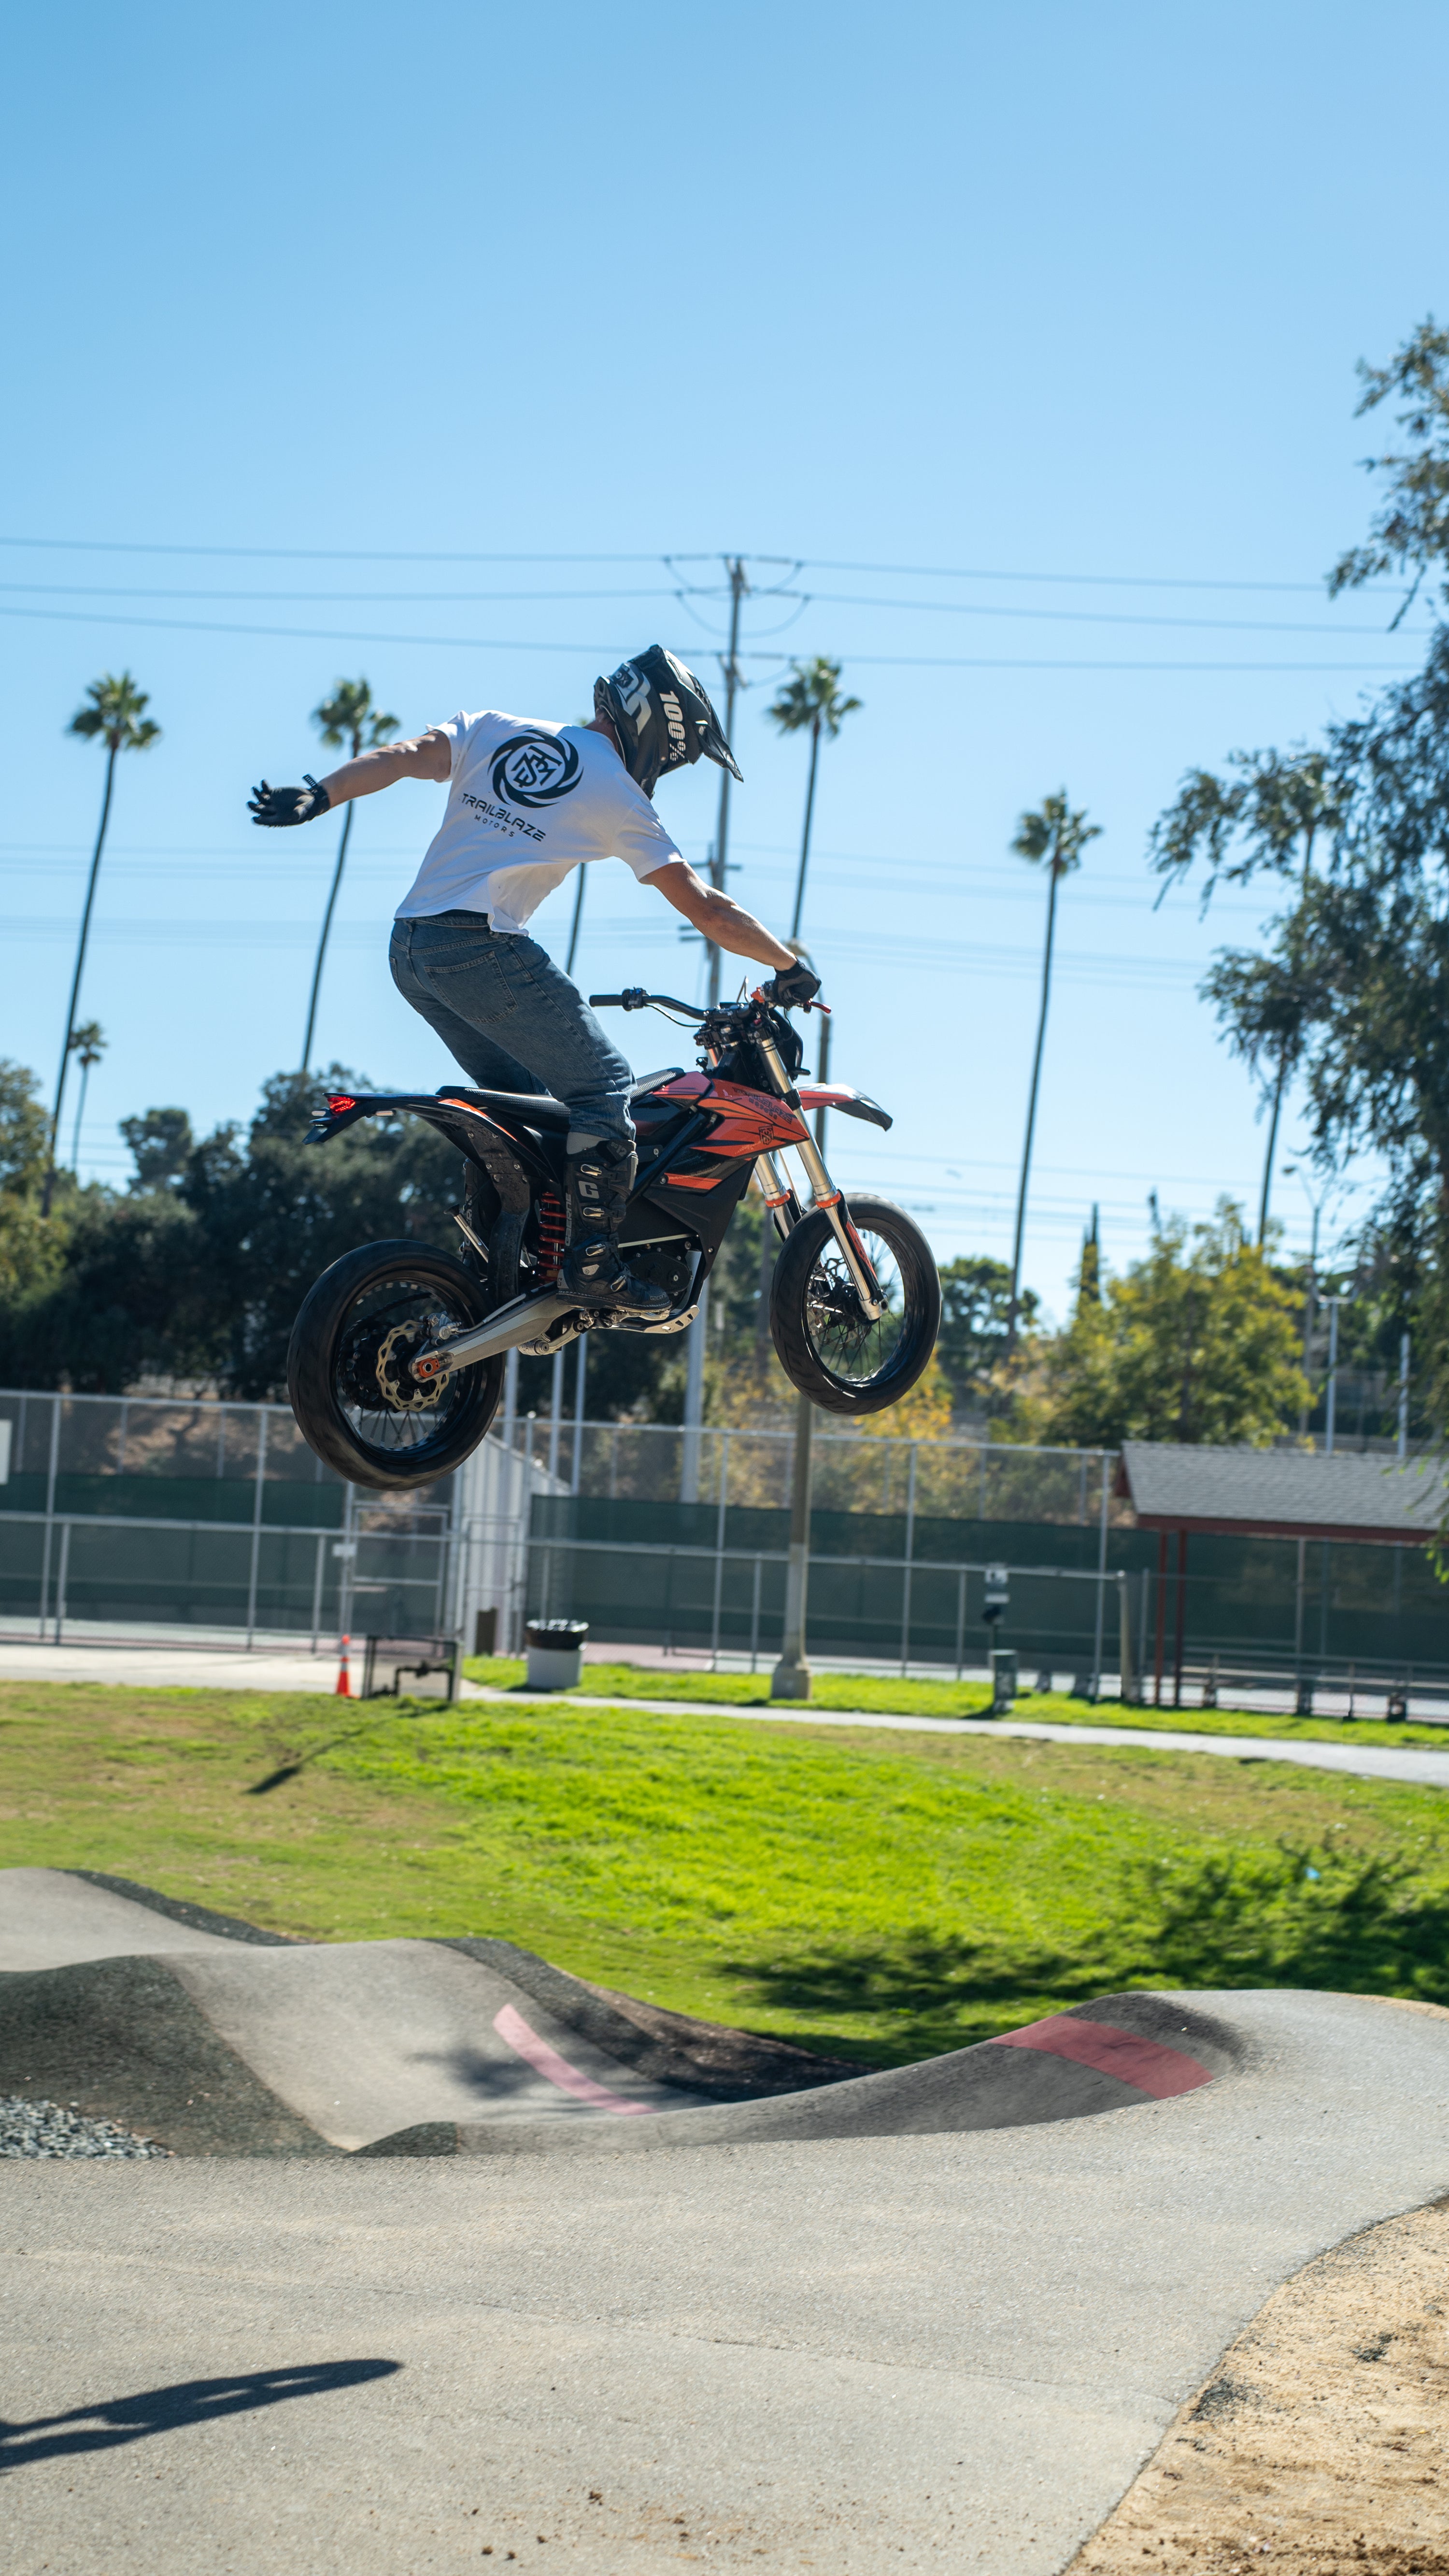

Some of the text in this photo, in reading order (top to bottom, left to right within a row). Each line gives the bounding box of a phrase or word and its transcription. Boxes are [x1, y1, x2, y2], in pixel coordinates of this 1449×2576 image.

[659, 690, 686, 761] 100%
[462, 793, 546, 842] TRAILBLAZE
[474, 814, 515, 837] MOTORS
[578, 1180, 599, 1199] G
